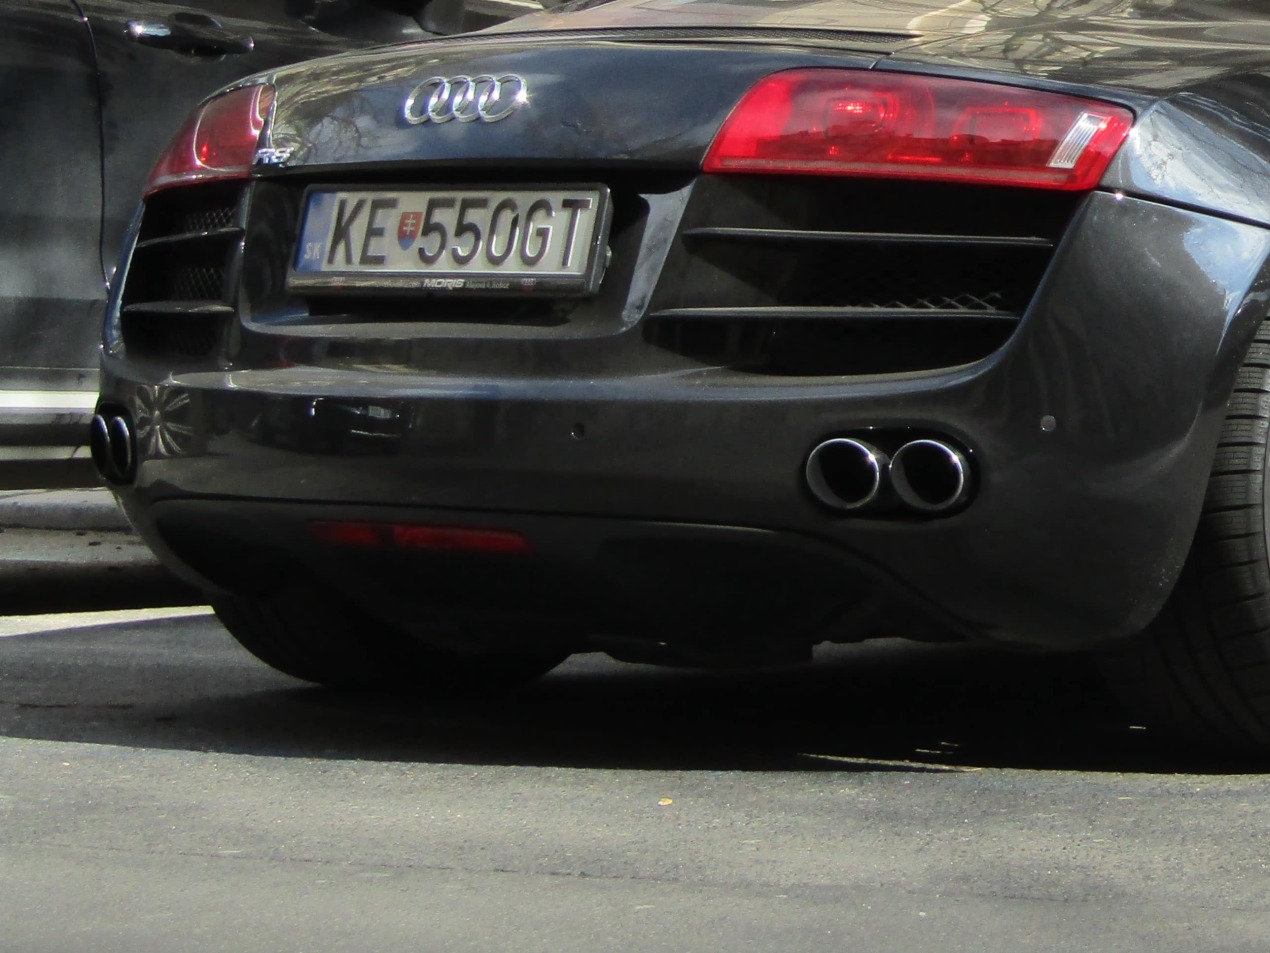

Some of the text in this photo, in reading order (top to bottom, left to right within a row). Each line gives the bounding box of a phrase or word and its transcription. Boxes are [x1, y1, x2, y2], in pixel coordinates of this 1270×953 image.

[303, 196, 593, 268] SK KE 550GT
[422, 278, 465, 290] MORIS
